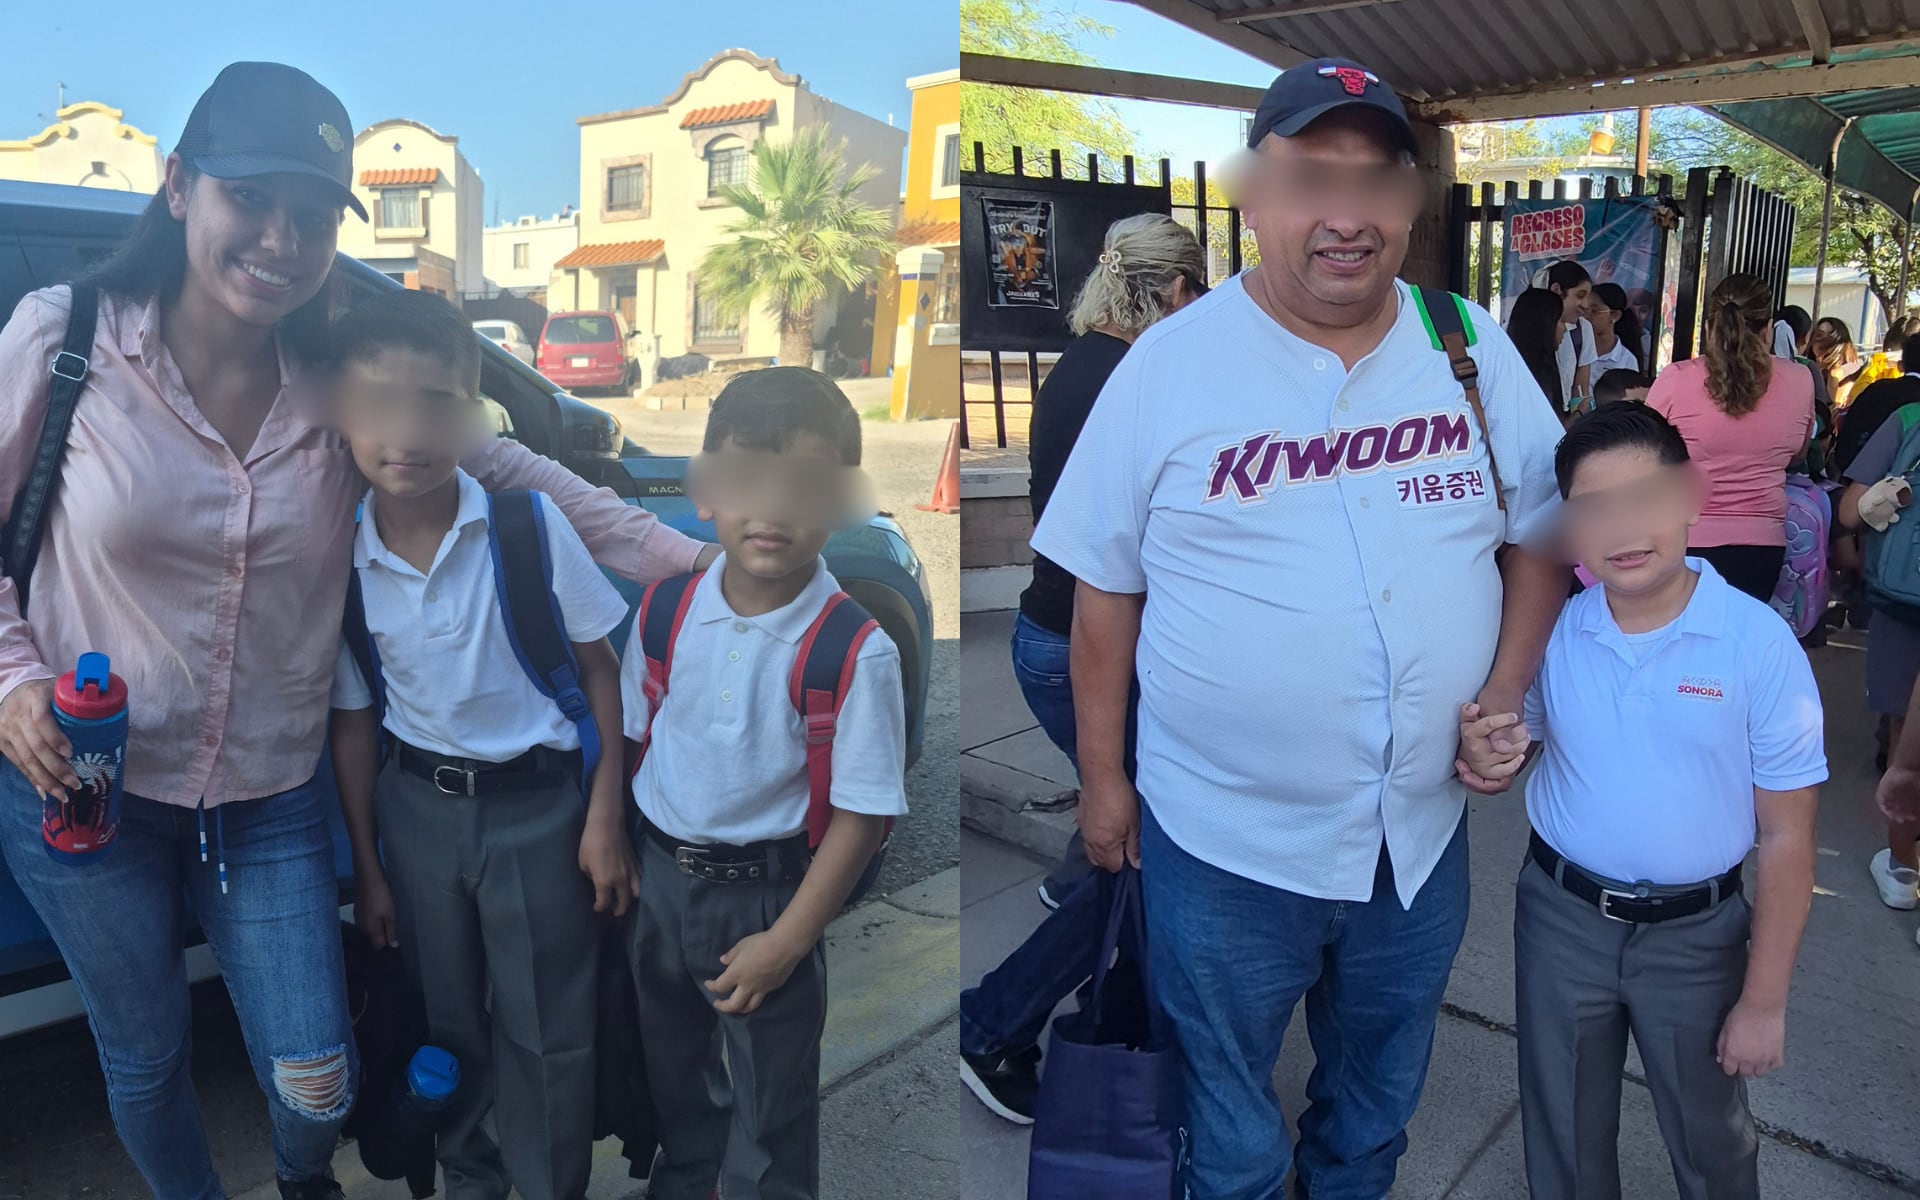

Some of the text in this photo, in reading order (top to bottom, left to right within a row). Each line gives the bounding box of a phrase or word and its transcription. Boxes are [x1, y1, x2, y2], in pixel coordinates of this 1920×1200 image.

[990, 222, 1047, 238] TRY OUT
[1511, 205, 1584, 236] REGRESO
[1511, 236, 1519, 250] A
[1519, 227, 1585, 254] CLASES
[1204, 411, 1473, 502] KIWOOM
[648, 486, 682, 494] MAGN
[1396, 470, 1486, 504] 키움증권
[1677, 685, 1723, 697] SONORA
